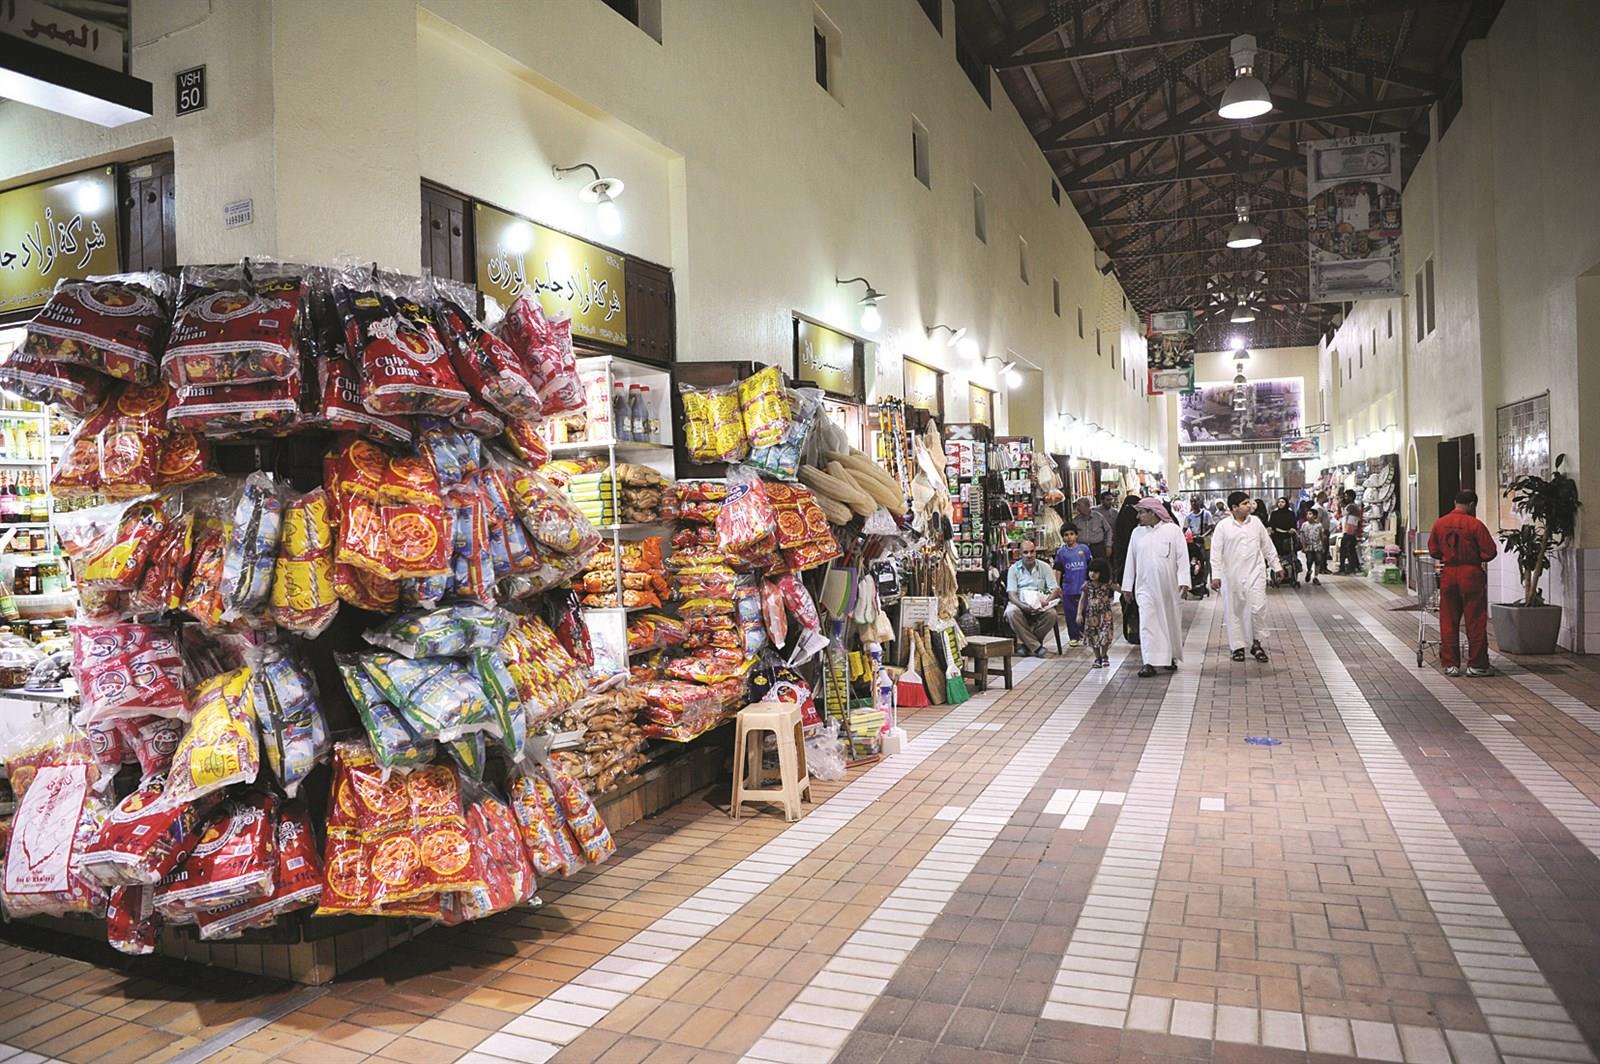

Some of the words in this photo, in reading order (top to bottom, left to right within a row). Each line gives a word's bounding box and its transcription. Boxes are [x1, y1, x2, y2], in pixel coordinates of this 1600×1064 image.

[180, 71, 201, 87] VSH
[181, 87, 200, 109] 50
[20, 207, 58, 276] أولاد
[57, 213, 106, 269] شركة
[592, 279, 622, 321] شركة
[375, 353, 409, 368] Chips
